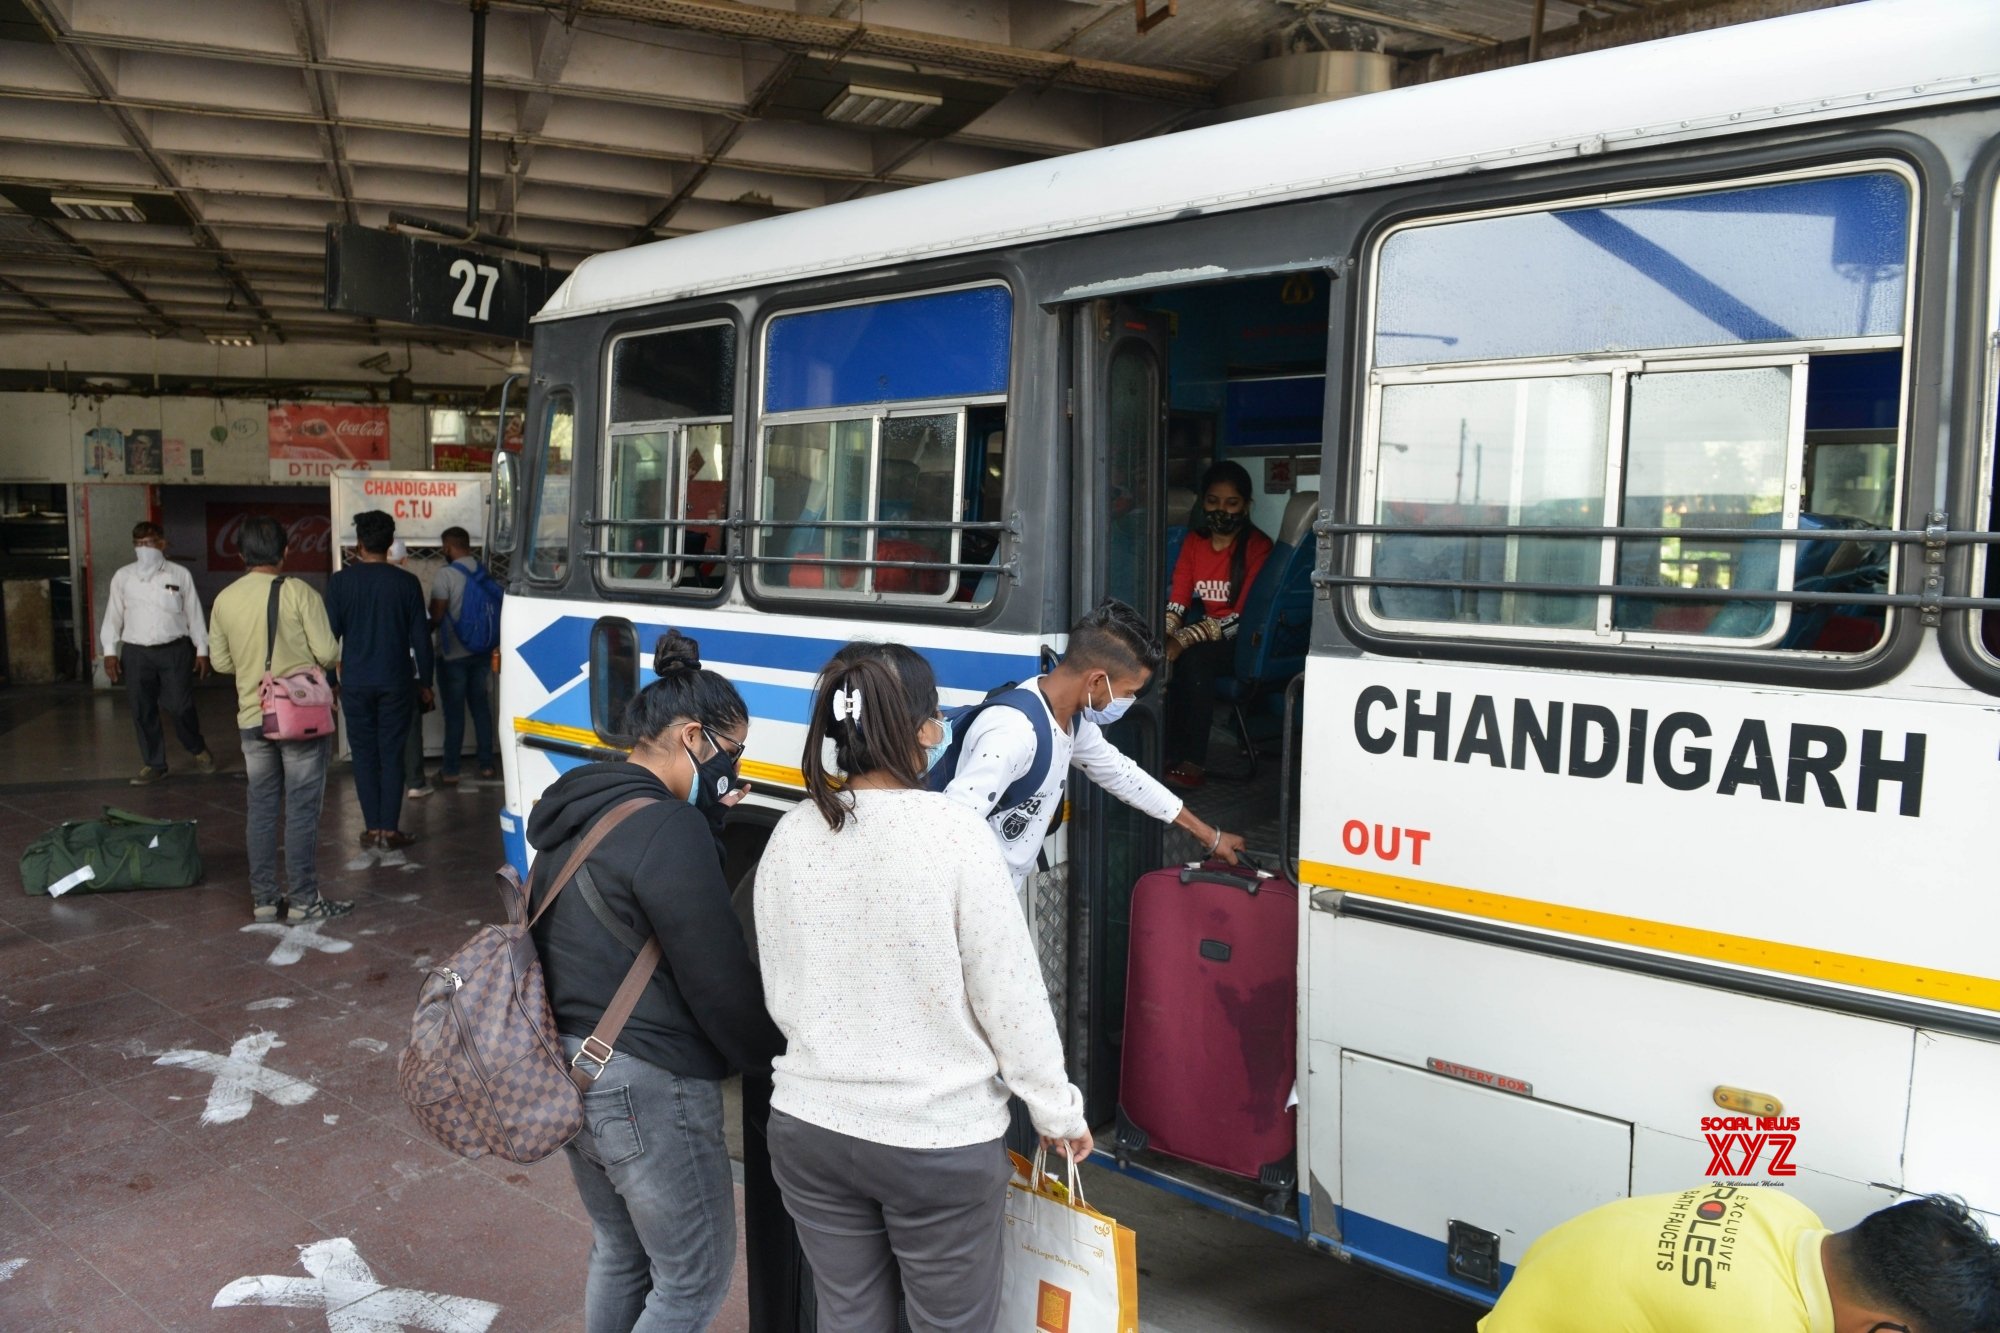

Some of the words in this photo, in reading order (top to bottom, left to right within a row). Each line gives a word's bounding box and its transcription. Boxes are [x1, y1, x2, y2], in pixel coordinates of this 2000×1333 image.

[450, 258, 499, 321] 27
[364, 480, 457, 497] CHANDIGARH
[1353, 684, 1928, 818] CHANDIGARH
[1342, 819, 1431, 866] OUT
[1434, 1060, 1494, 1083] BATTERY
[1498, 1077, 1527, 1092] BOX
[1672, 1190, 1700, 1210] BATH
[1656, 1212, 1686, 1272] FAUCETS
[1682, 1185, 1738, 1289] ROLES
[1716, 1195, 1749, 1272] EXCLUSIVE
